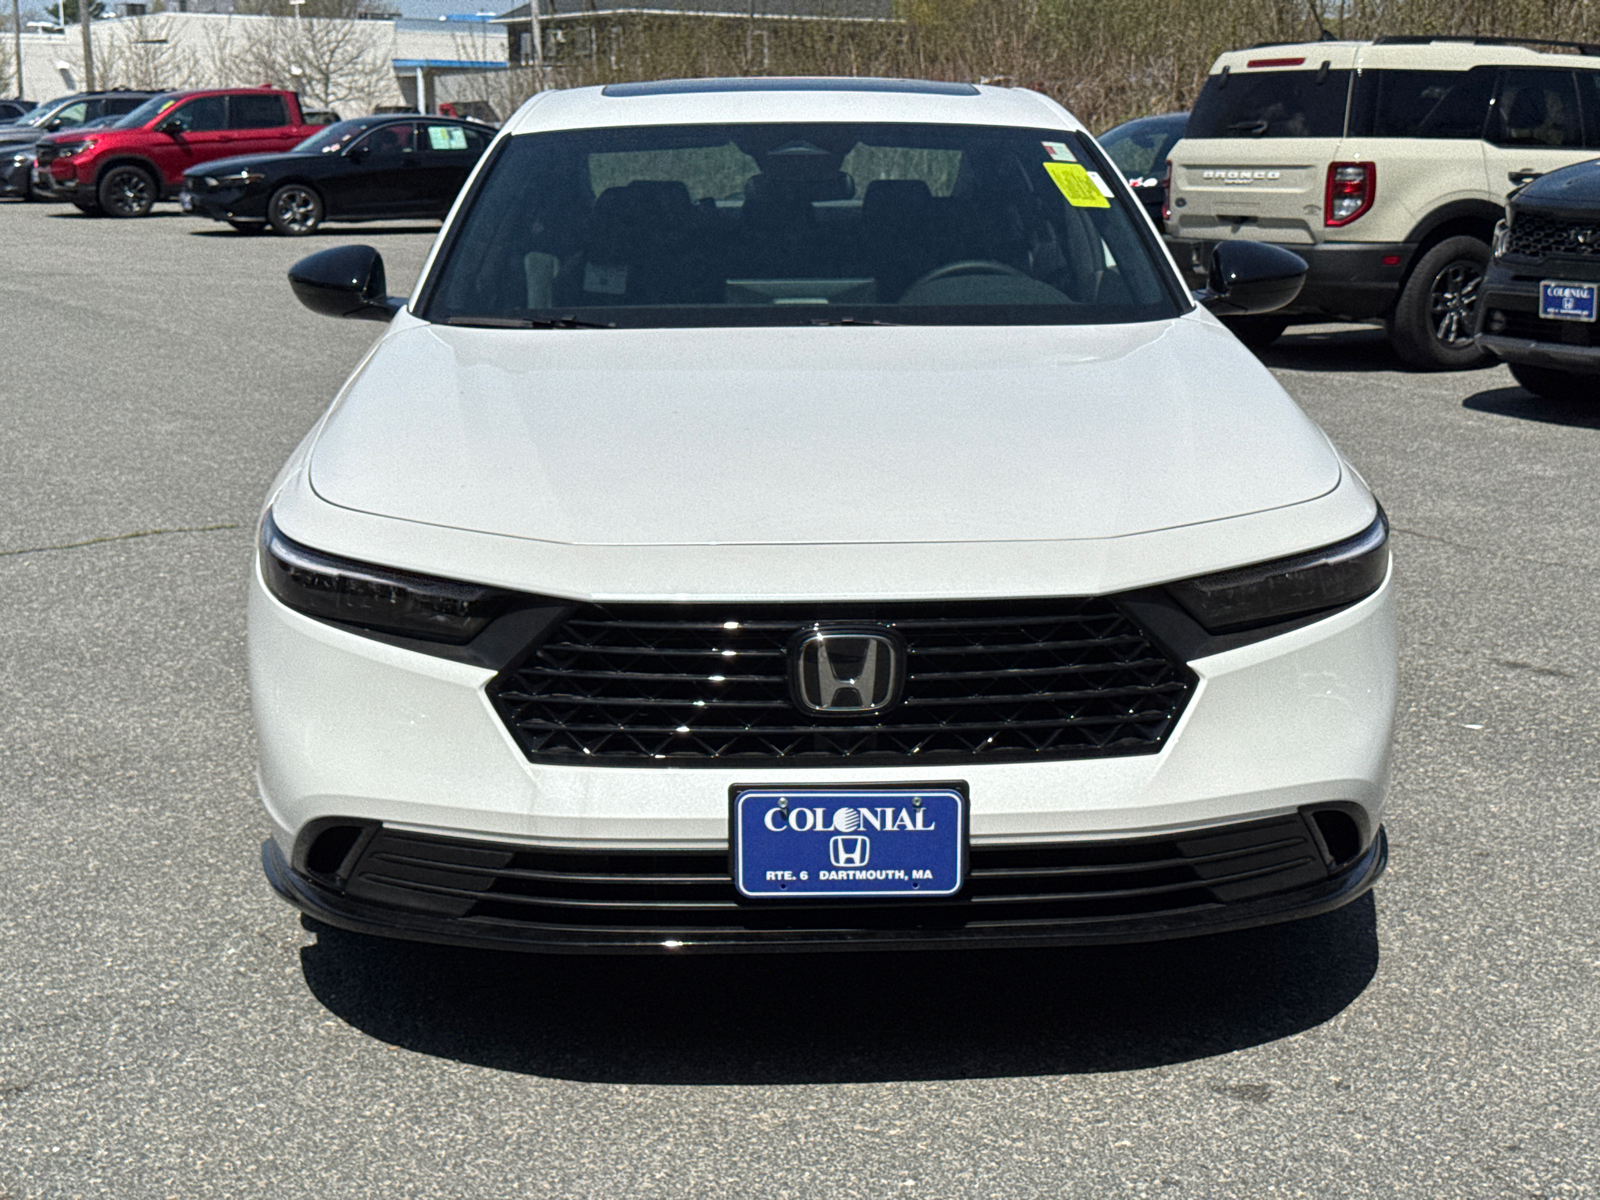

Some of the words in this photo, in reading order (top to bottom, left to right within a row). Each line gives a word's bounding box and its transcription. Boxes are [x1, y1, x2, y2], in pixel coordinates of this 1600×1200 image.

[1202, 170, 1280, 180] BRONCO
[764, 807, 935, 832] COLONIAL
[766, 870, 797, 881] RTE.
[799, 870, 809, 881] 6
[819, 869, 909, 881] DARTMOUTH,
[912, 869, 933, 879] MA
